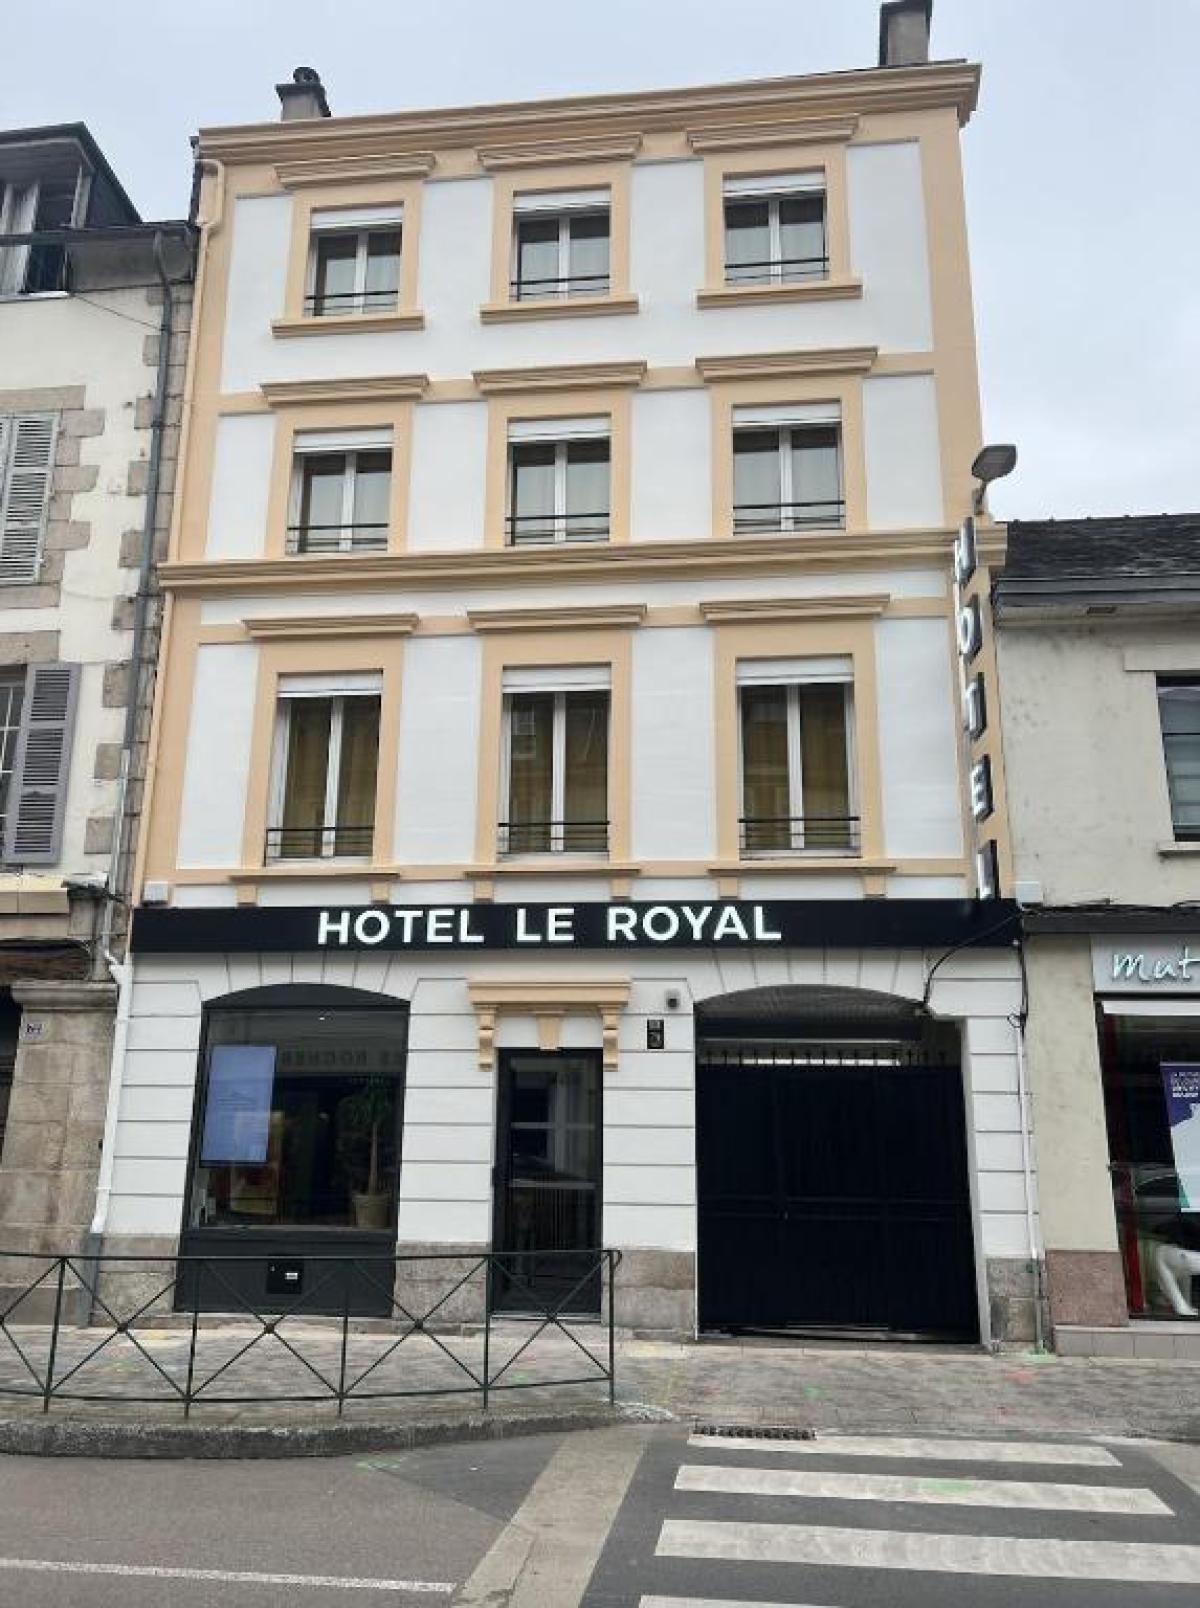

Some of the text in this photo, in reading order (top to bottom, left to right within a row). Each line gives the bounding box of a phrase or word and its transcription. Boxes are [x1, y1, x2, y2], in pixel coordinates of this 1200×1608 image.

[317, 905, 782, 944] HOTEL LE ROYAL
